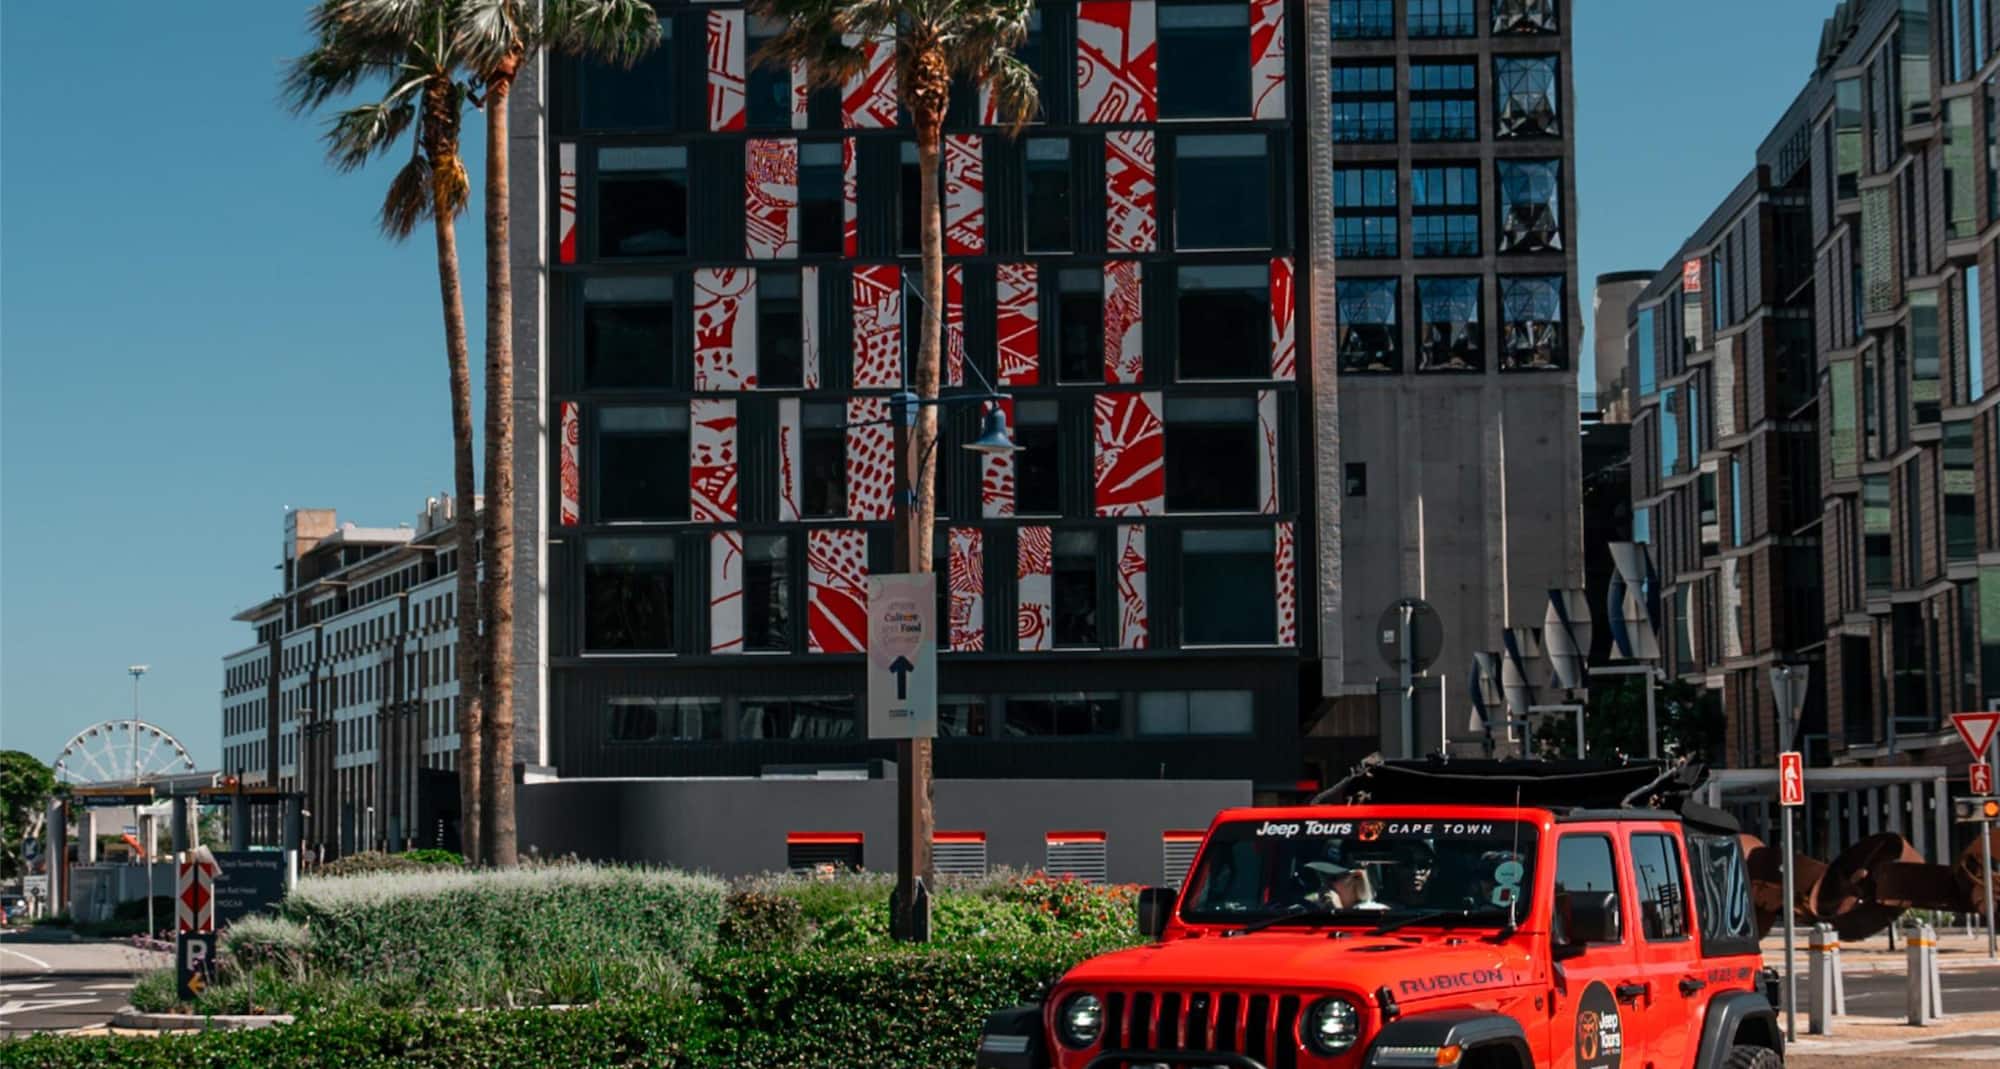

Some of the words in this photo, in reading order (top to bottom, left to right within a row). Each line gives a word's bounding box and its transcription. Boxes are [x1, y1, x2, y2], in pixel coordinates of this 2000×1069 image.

[900, 621, 921, 632] Food
[1256, 821, 1299, 838] Jeep
[1304, 821, 1352, 835] Tours
[1388, 823, 1433, 834] CAPE
[1443, 823, 1493, 834] TOWN
[187, 939, 208, 971] P
[1399, 969, 1504, 995] RUBICON
[1599, 1011, 1619, 1033] Jeep
[1599, 1030, 1621, 1049] Tours
